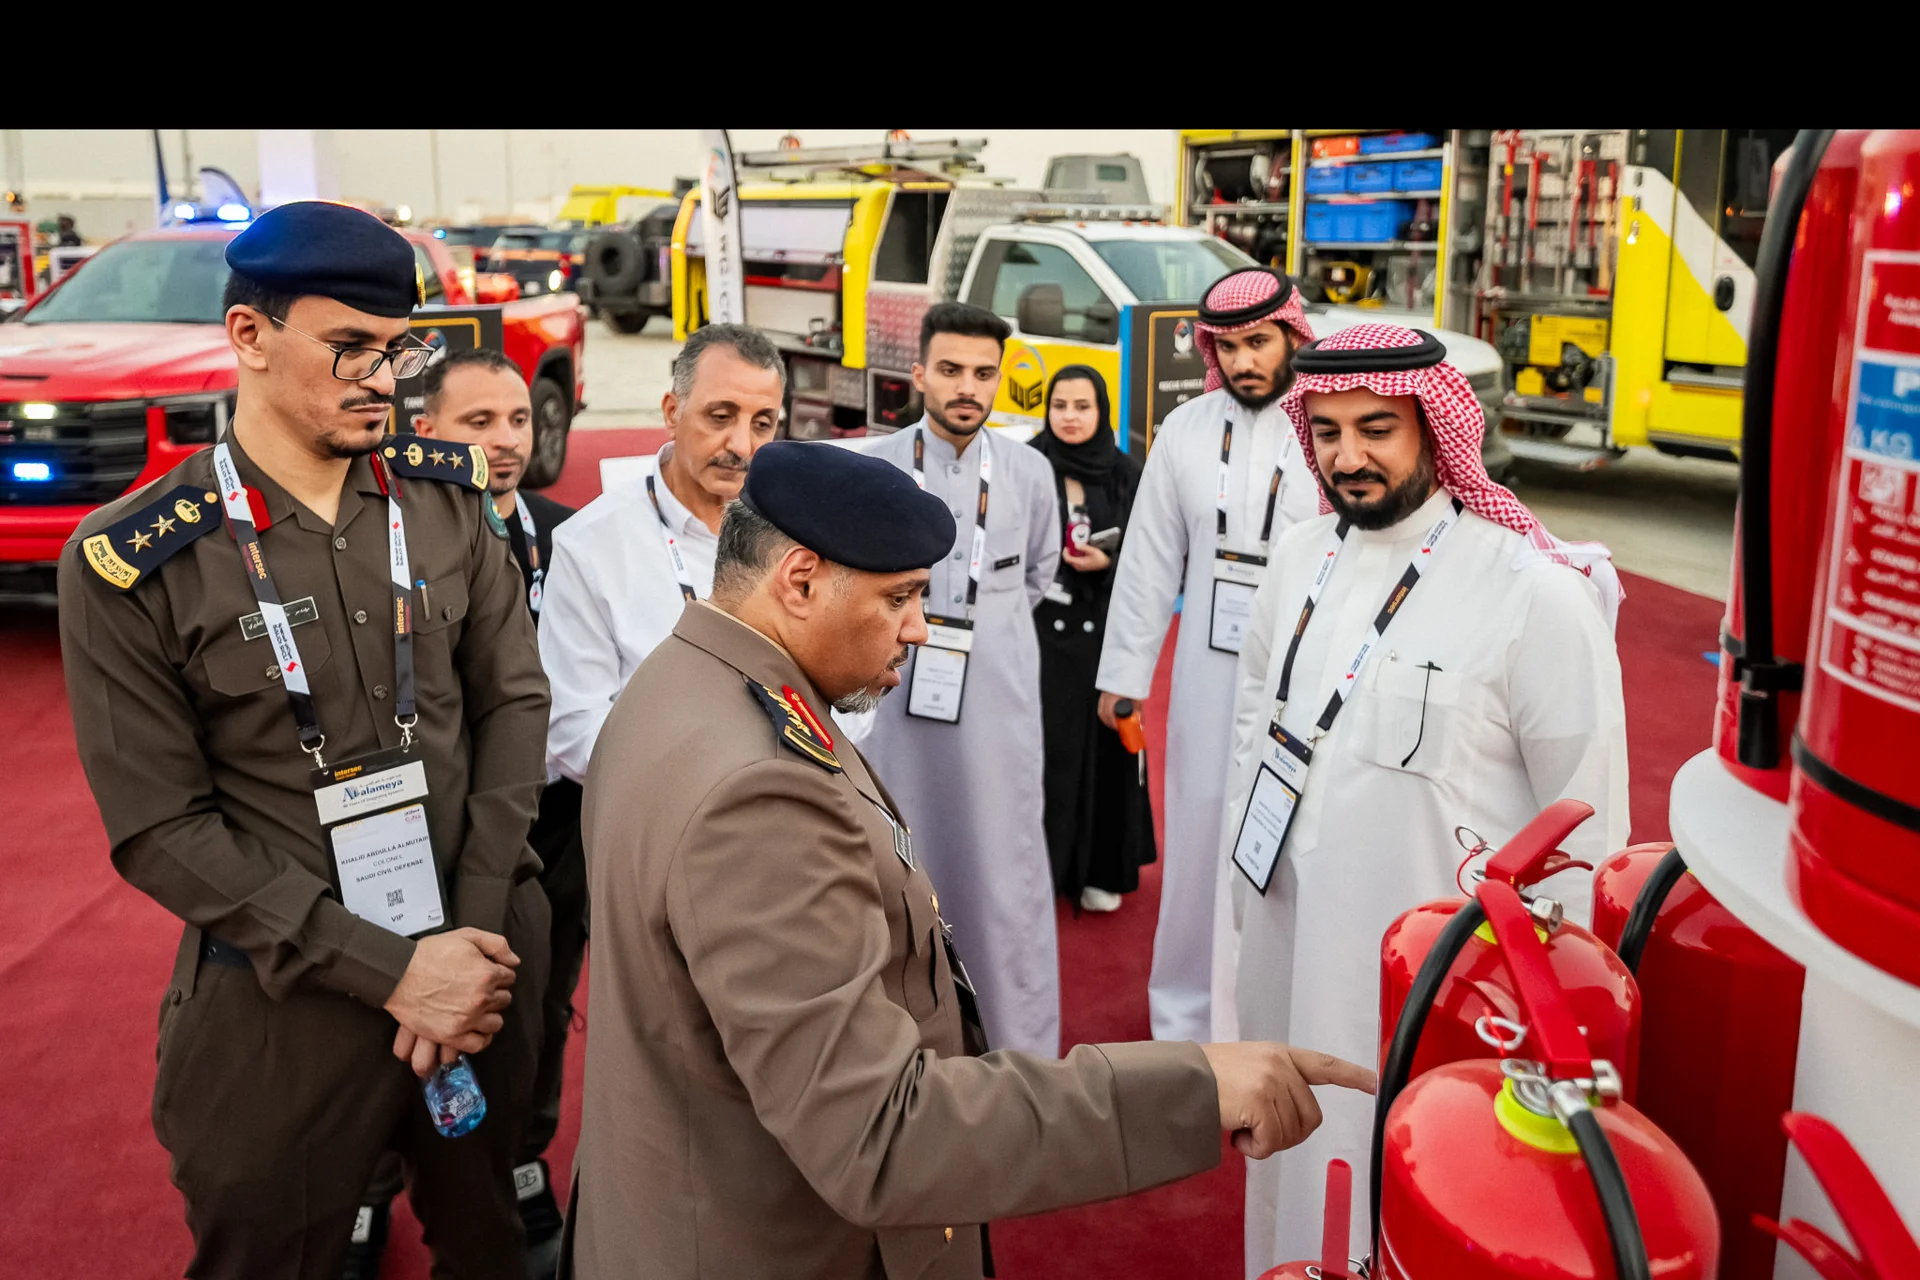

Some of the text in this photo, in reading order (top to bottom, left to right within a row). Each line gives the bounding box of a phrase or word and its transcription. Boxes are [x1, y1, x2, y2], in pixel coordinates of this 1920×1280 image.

[248, 541, 267, 580] intersec
[396, 597, 405, 634] intersec
[273, 624, 282, 644] SAUDI
[334, 765, 362, 778] intersec
[341, 855, 365, 865] KHALID
[366, 845, 396, 858] ABDULLA
[373, 854, 403, 867] COLONEL
[356, 859, 423, 882] SAUDI CIVIL DEFENSE
[391, 914, 404, 923] VIP
